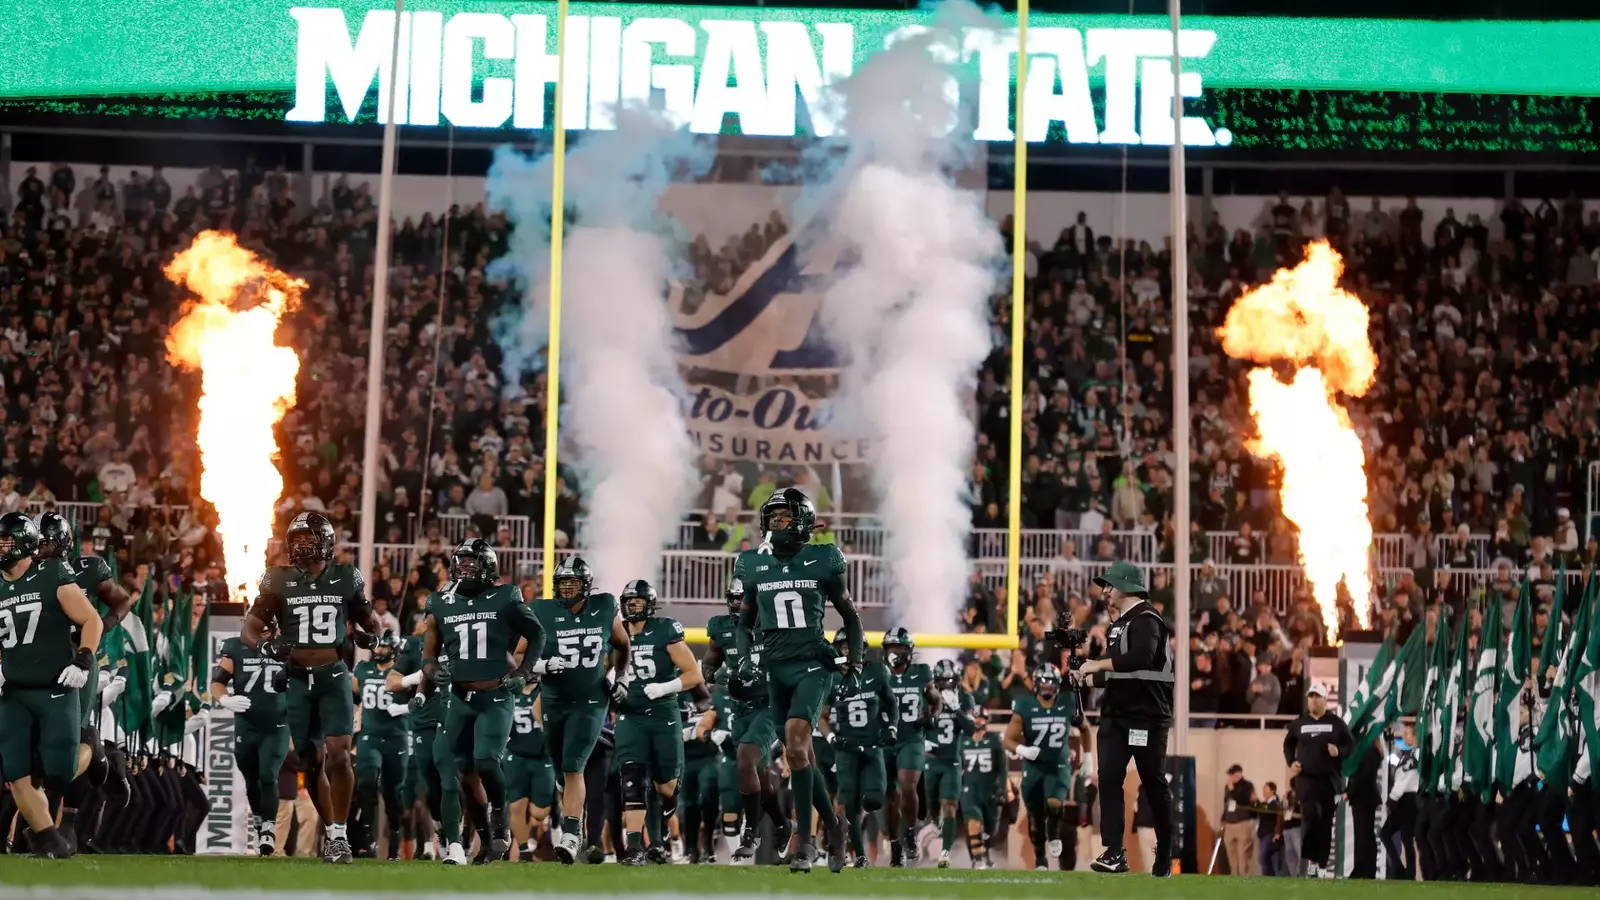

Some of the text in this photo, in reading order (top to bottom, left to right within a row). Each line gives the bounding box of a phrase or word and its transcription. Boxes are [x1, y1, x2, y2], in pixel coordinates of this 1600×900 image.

[285, 7, 853, 137] MICHIGAN
[20, 592, 41, 602] STATE
[757, 580, 818, 592] MICHIGAN STATE
[286, 595, 343, 605] MICHIGAN STATE
[0, 602, 42, 648] 97
[293, 605, 338, 643] 19
[443, 612, 497, 624] MICHIGAN STATE
[454, 622, 487, 659] 11
[556, 626, 603, 637] MICHIGAN STATE
[558, 635, 603, 668] 53
[362, 684, 393, 709] 66
[848, 700, 868, 727] 6
[938, 719, 954, 744] 3
[1031, 723, 1066, 748] 72
[965, 753, 992, 773] 75
[207, 717, 235, 849] MICHIGAN
